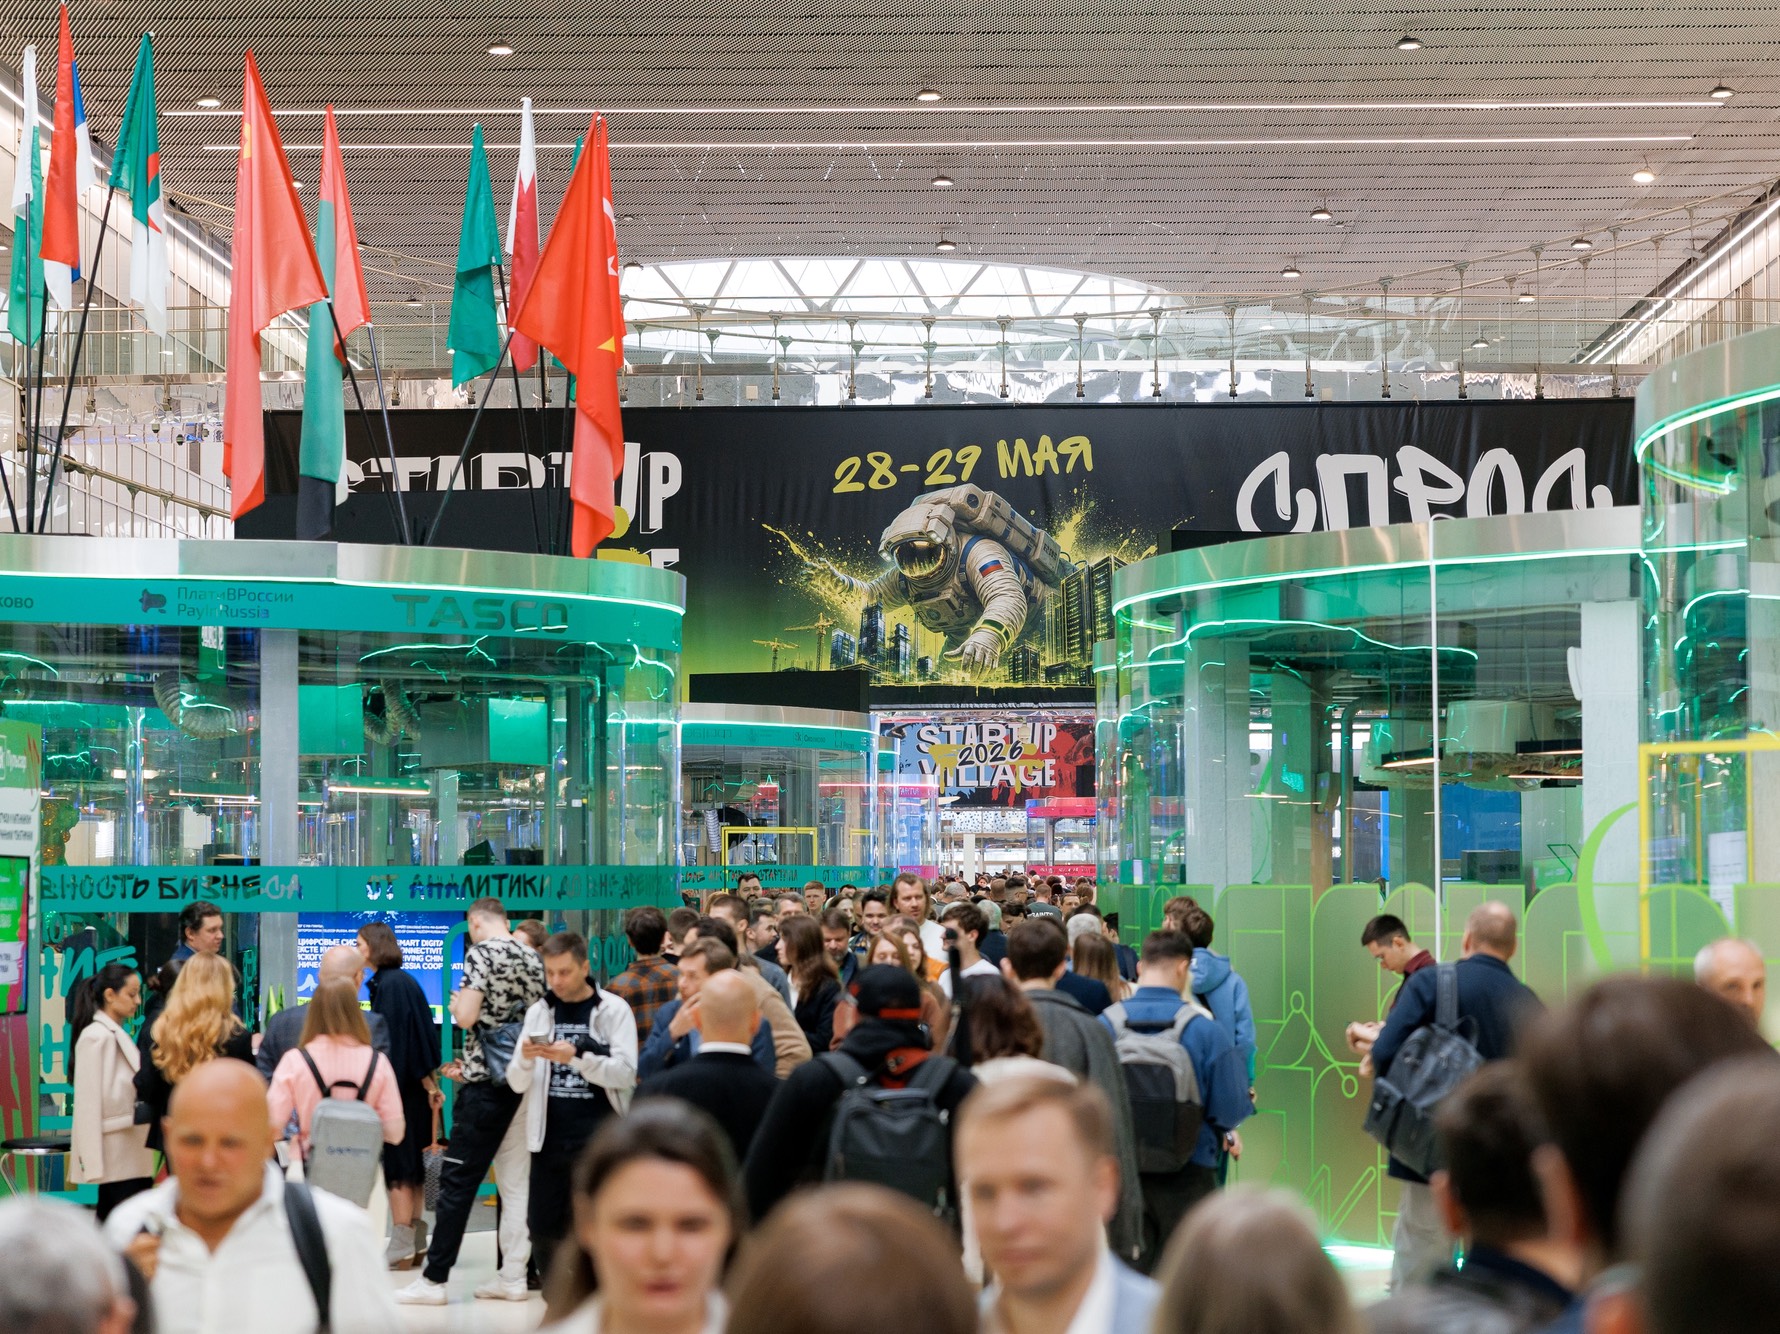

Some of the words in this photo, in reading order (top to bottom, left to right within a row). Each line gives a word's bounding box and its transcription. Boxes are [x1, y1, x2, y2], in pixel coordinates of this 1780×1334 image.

[832, 445, 982, 494] 28-29
[996, 434, 1094, 479] МАЯ
[392, 594, 568, 634] TASCO
[917, 723, 1057, 754] STARTUP
[957, 740, 1024, 767] 2026
[917, 758, 1057, 787] VILLAGE
[158, 874, 303, 900] БИЗНЕСА
[298, 938, 340, 946] ЦИФРОВЫЕ
